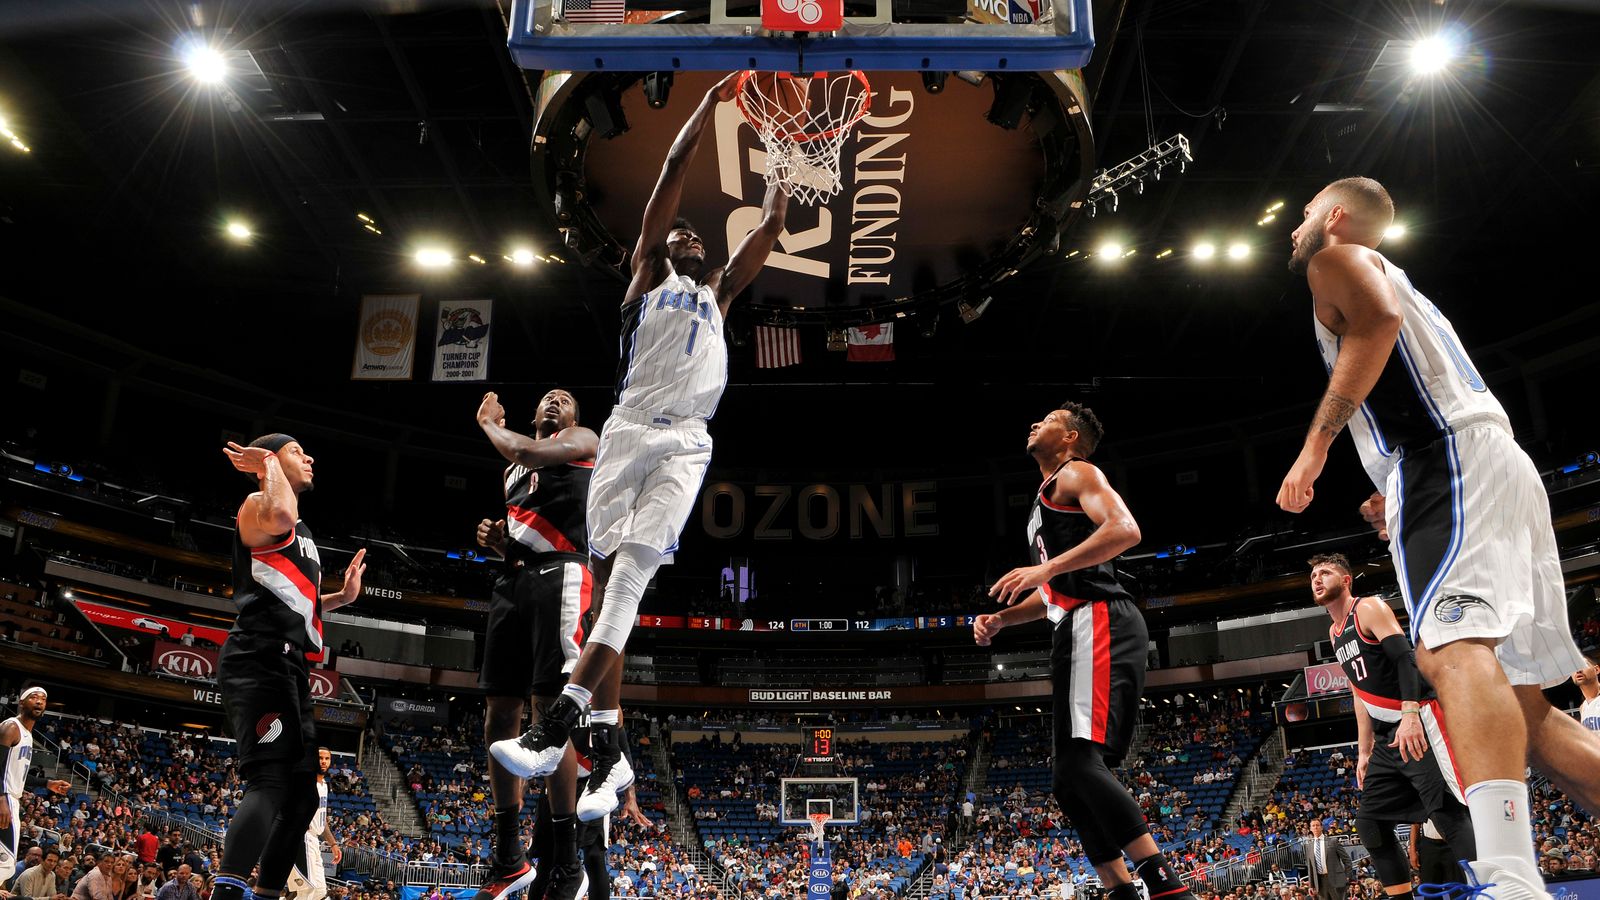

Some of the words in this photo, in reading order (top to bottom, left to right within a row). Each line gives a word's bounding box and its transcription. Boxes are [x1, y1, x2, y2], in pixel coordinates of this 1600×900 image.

[1012, 13, 1029, 23] NBA
[847, 86, 914, 286] FUNDING
[685, 319, 699, 356] 1
[443, 352, 467, 361] TURNER
[469, 352, 481, 360] CUP
[362, 363, 386, 371] Amway
[443, 361, 479, 370] CHAMPIONS
[446, 370, 474, 378] 2000-2001
[702, 482, 939, 540] OZONE
[365, 586, 402, 600] WEEDS
[768, 621, 785, 630] 124
[819, 621, 833, 629] 1:00
[855, 621, 870, 629] 112
[167, 654, 203, 676] KIA
[1351, 656, 1368, 681] 27
[193, 689, 223, 705] WEE
[751, 691, 775, 700] BUD
[776, 691, 809, 700] LIGHT
[812, 691, 866, 700] BASELINE
[868, 690, 892, 700] BAR
[408, 703, 436, 713] FLORIDA
[814, 729, 831, 739] 1:00
[814, 739, 829, 755] 13
